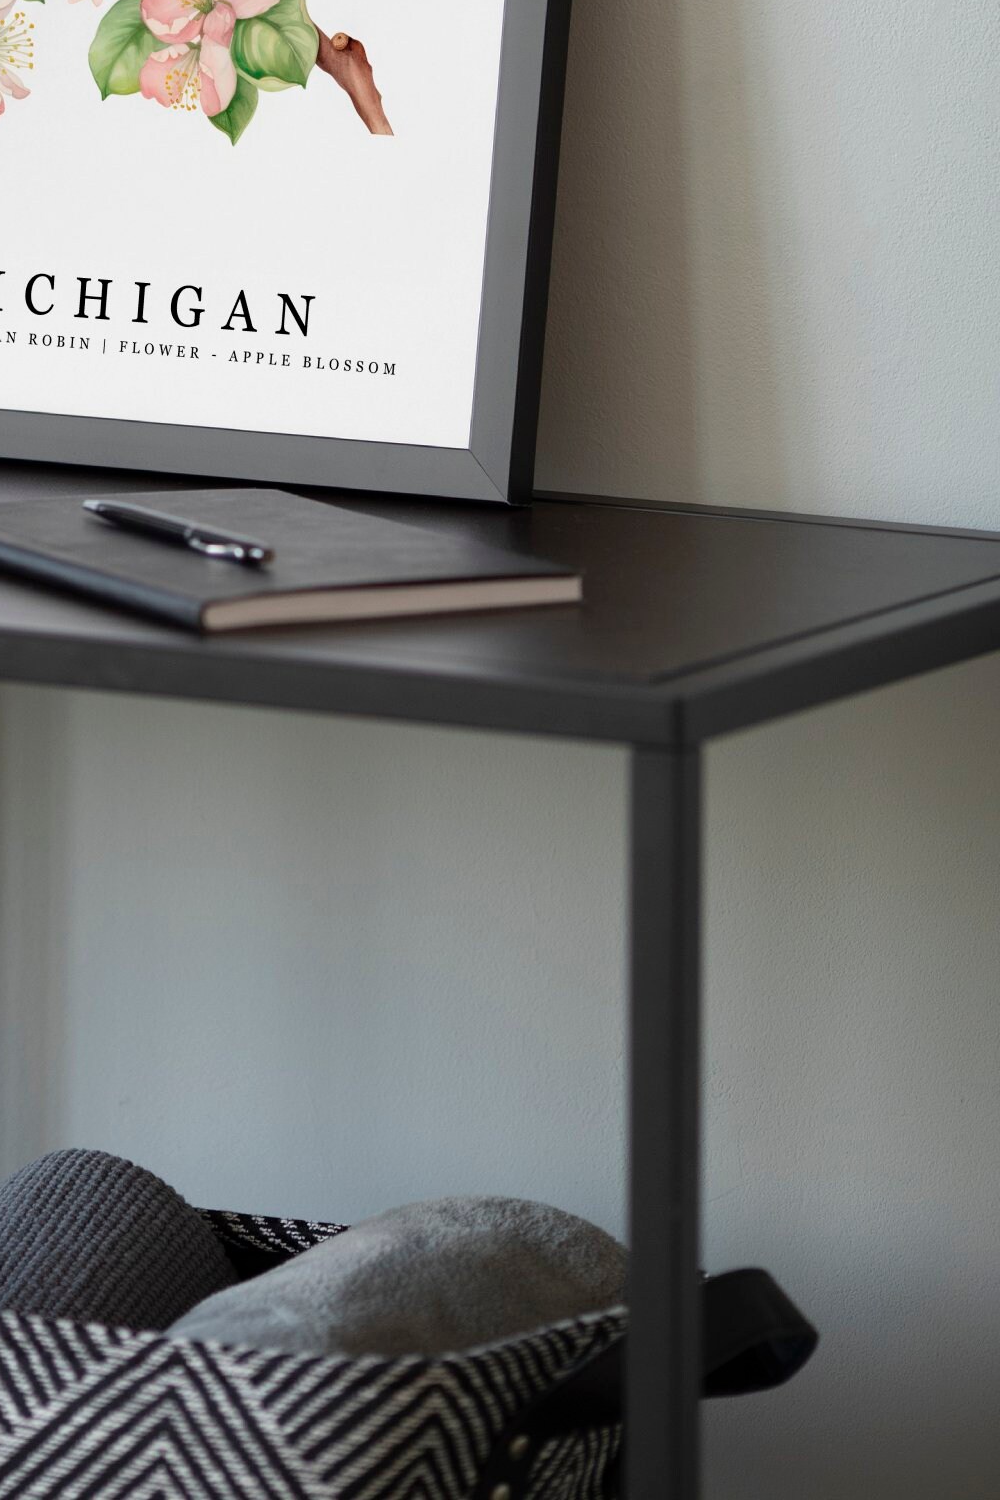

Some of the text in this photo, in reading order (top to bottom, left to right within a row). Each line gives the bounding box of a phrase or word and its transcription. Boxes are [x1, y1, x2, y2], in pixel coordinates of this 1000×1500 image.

[28, 333, 91, 350] ROBIN
[119, 340, 200, 359] FLOWER
[228, 350, 292, 367] APPLE
[302, 355, 398, 376] BLOSSOM
